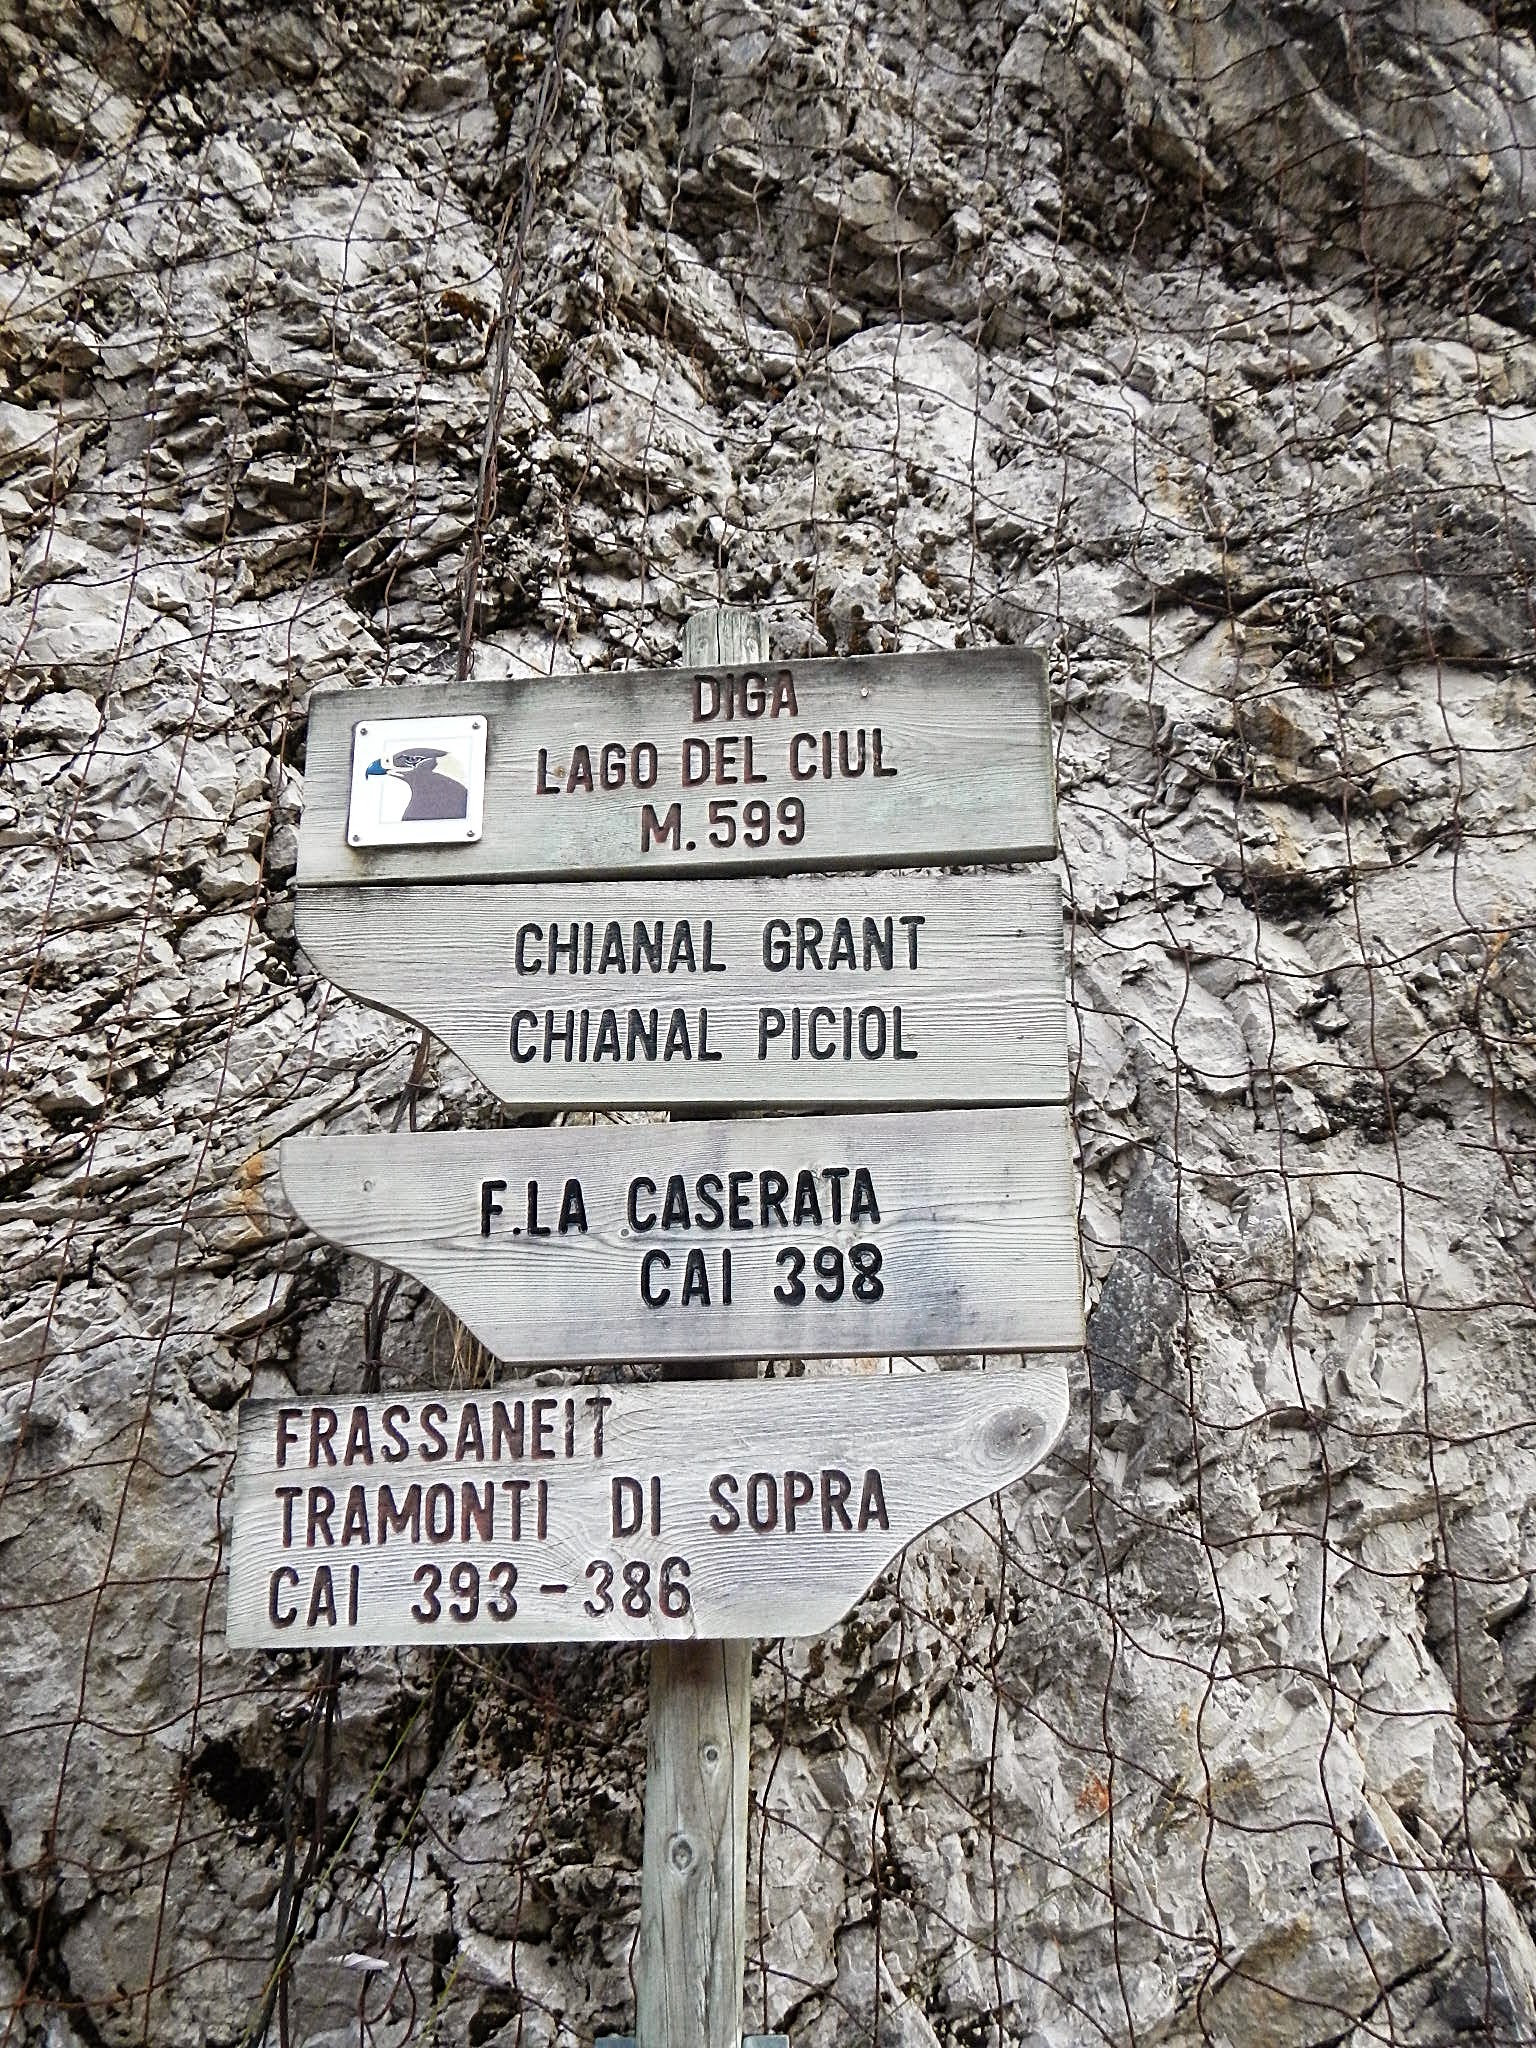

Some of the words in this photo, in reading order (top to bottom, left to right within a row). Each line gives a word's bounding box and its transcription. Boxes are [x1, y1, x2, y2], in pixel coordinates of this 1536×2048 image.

[692, 669, 799, 722] DIGA
[537, 741, 658, 794] LAGO
[682, 735, 767, 788] DEL
[789, 727, 898, 781] CIUL
[515, 919, 726, 976] CHIANAL
[762, 916, 925, 972] GRANT
[509, 1007, 722, 1064] CHIANAL
[757, 1005, 918, 1061] PICIOL
[627, 1166, 882, 1233] CASERATA
[641, 1247, 732, 1307] CAI
[774, 1242, 884, 1306] 398
[275, 1396, 612, 1468] FRASSANEIT
[275, 1479, 549, 1548] TRAMONTI
[612, 1474, 661, 1538] DI
[709, 1468, 890, 1535] SOPRA
[269, 1563, 360, 1628] CAI
